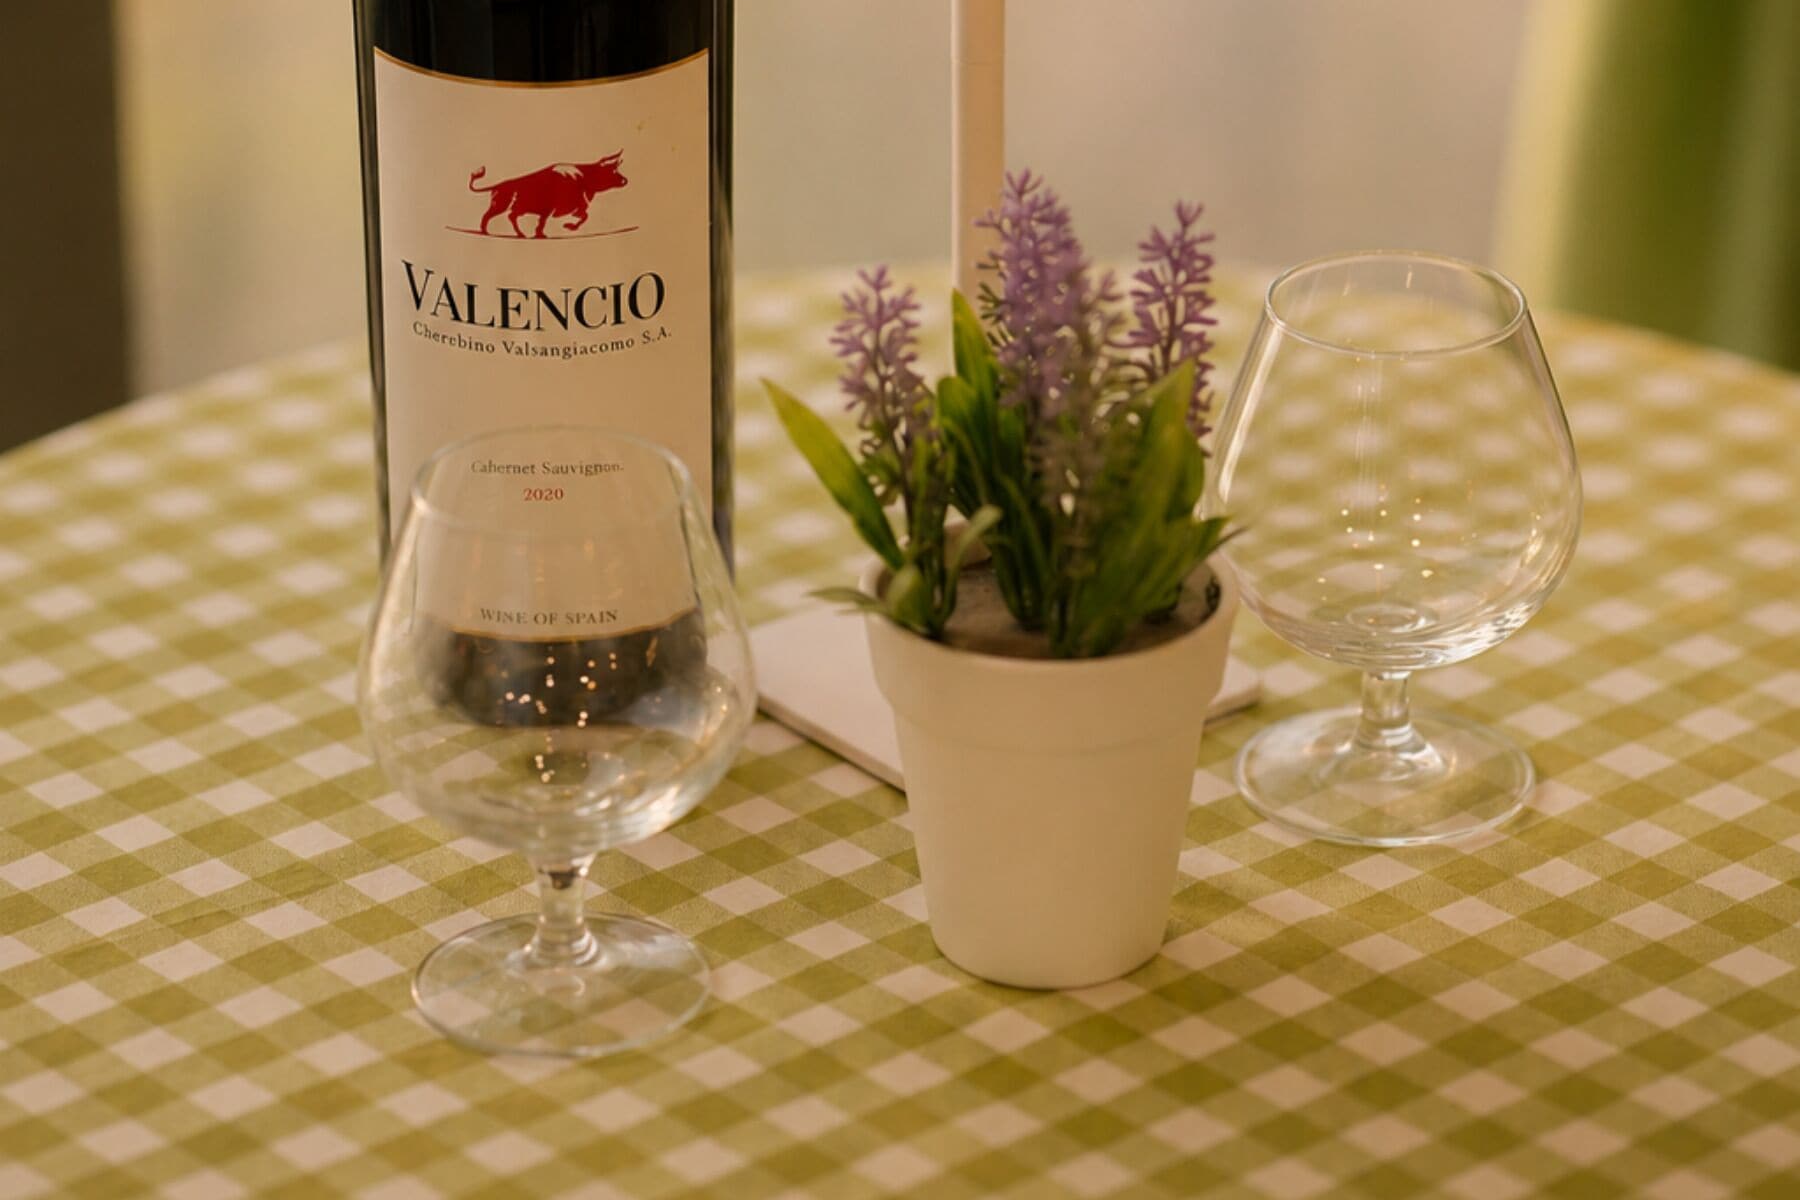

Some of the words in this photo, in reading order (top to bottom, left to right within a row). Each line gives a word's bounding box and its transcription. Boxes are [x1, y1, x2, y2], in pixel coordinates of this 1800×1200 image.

[402, 260, 665, 331] VALENCIO
[502, 336, 635, 361] Valsangiacomo
[641, 324, 672, 345] S.A.
[523, 487, 564, 502] 2020
[480, 608, 529, 625] WINE
[533, 611, 559, 625] OF
[564, 608, 618, 625] SPAIN
